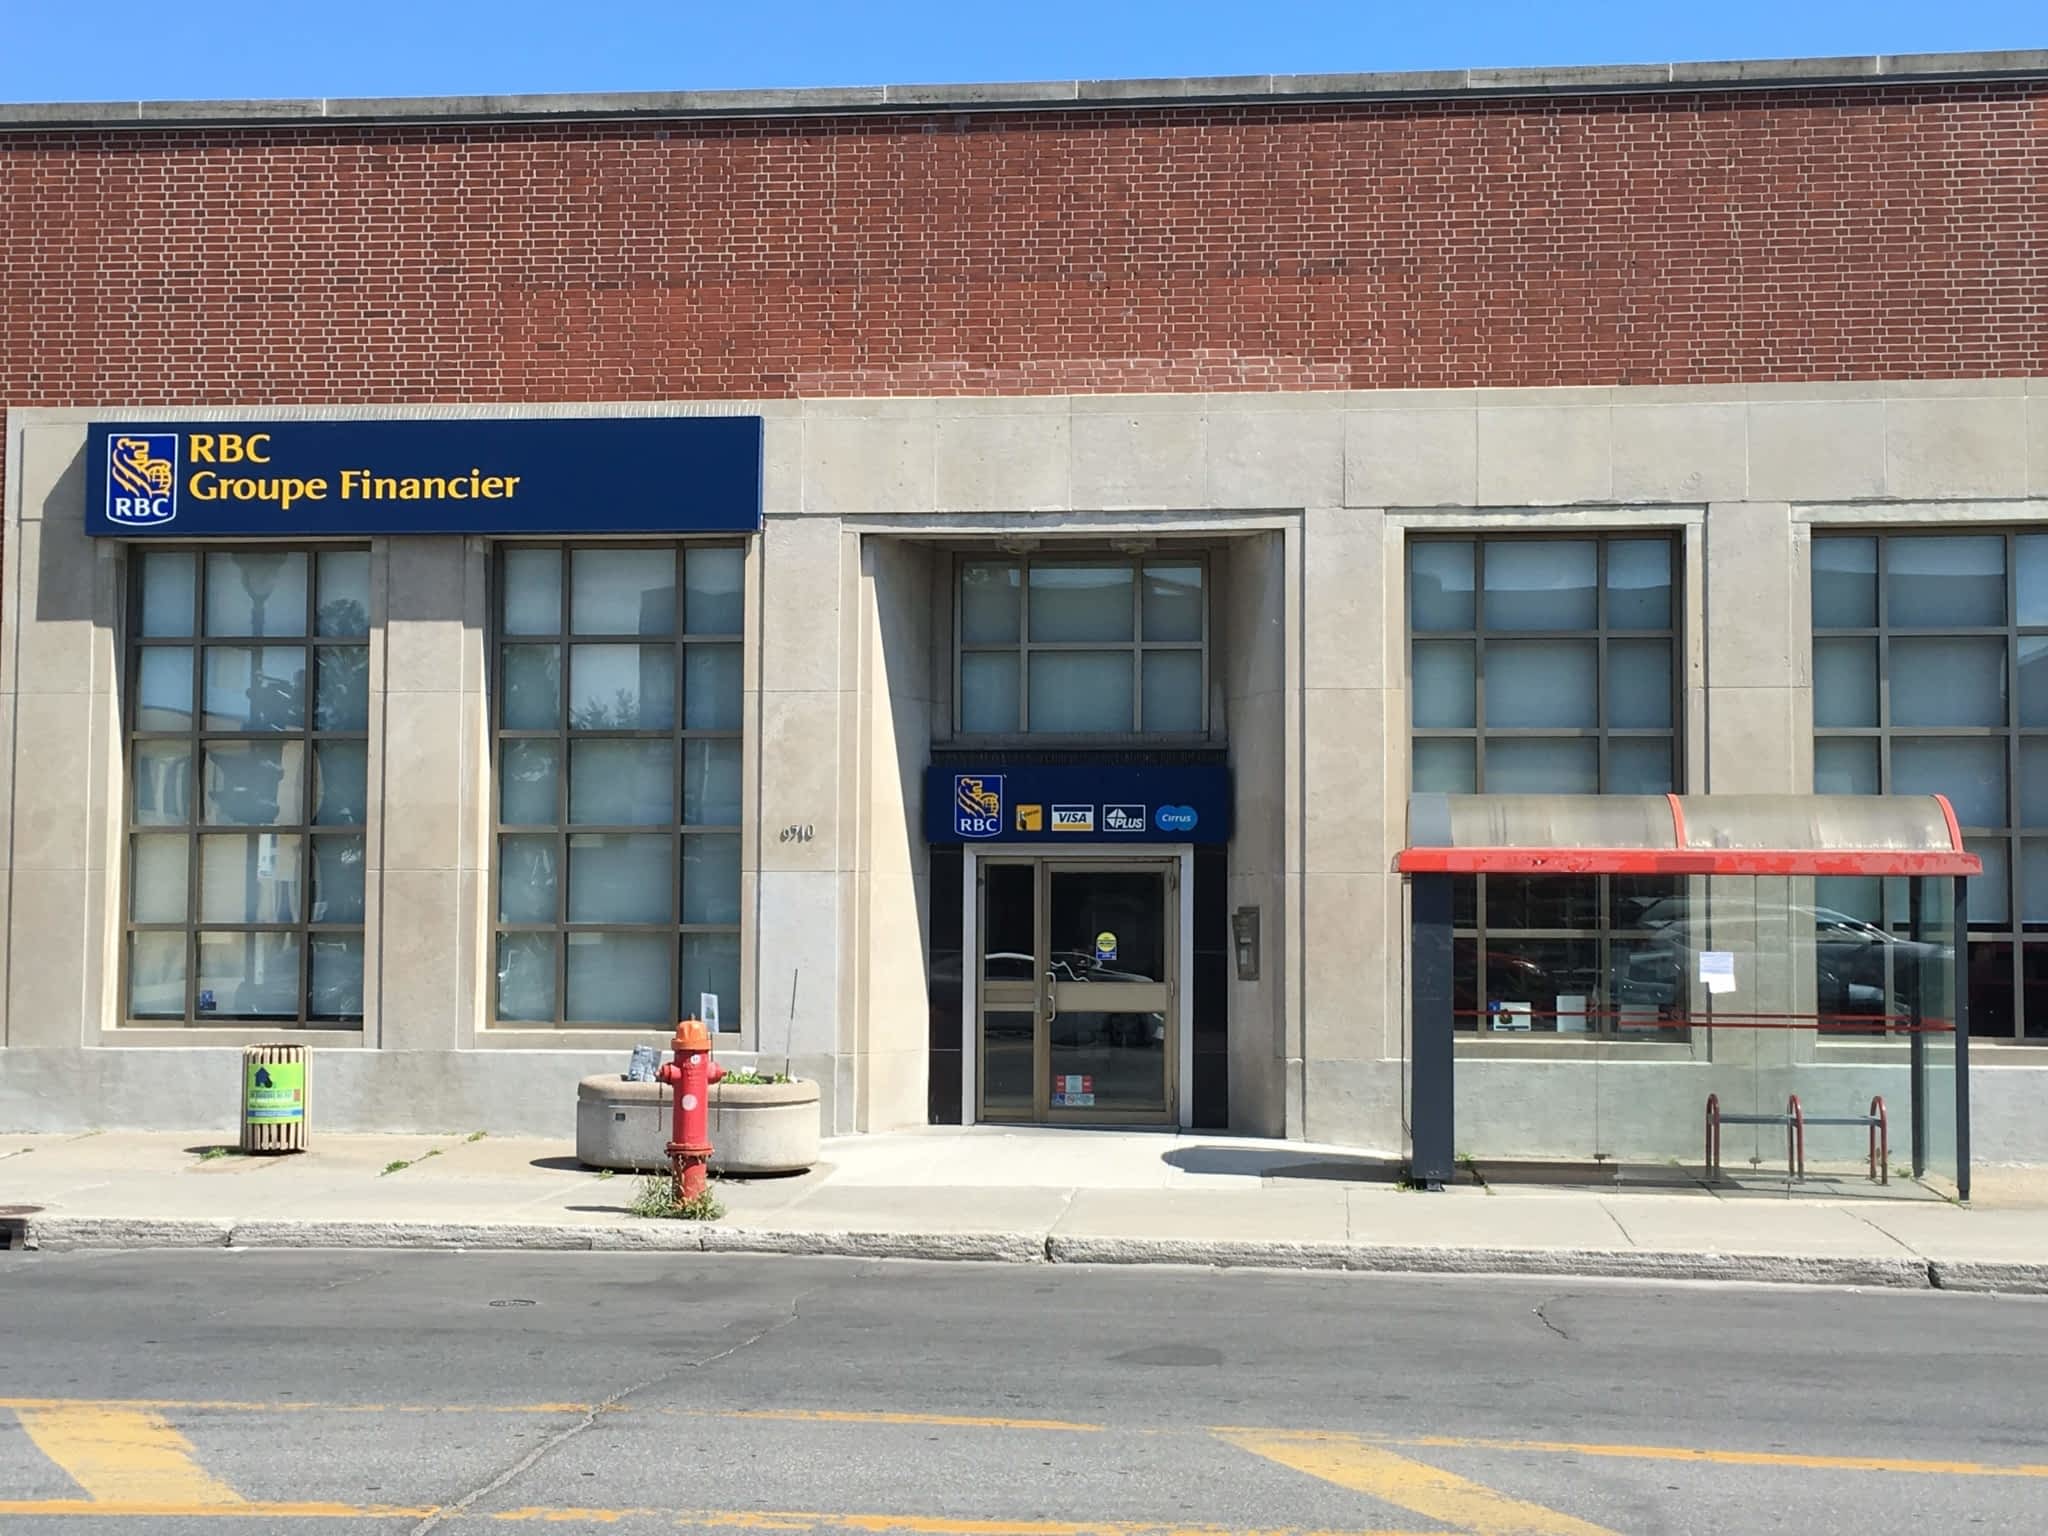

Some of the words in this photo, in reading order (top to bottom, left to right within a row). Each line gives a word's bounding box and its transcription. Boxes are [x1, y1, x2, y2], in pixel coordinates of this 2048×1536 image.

[189, 434, 271, 463] RBC
[189, 470, 328, 509] Groupe
[340, 469, 521, 500] Financier
[115, 498, 169, 517] RBC
[961, 818, 998, 832] RBC
[1058, 812, 1087, 824] VISA
[1115, 817, 1143, 829] PLUS
[1161, 813, 1191, 823] Cirrus
